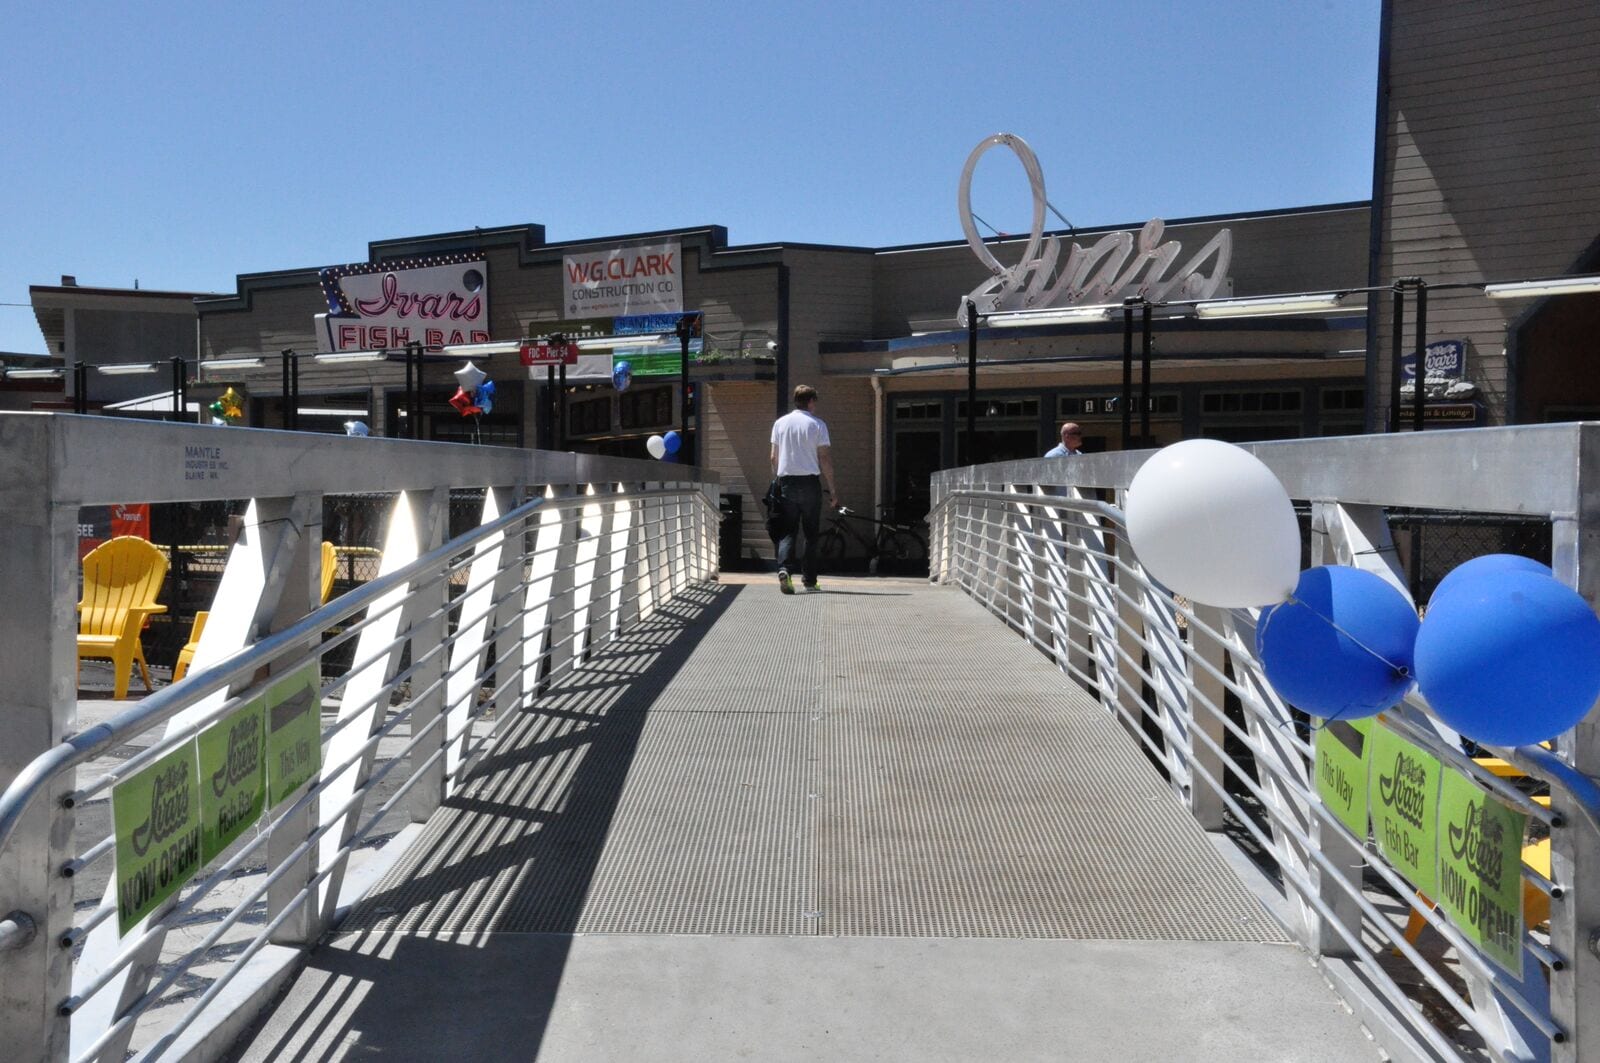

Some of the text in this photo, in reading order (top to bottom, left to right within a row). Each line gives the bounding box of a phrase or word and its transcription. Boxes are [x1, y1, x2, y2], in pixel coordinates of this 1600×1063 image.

[572, 282, 655, 301] CONSTRUCTION
[339, 324, 410, 351] FISH
[528, 347, 540, 359] FDC
[546, 347, 558, 358] Pier
[185, 446, 220, 459] MANTLE
[1322, 751, 1353, 811] This Way
[219, 798, 236, 839] Fish
[1385, 816, 1419, 870] Fish Bar
[122, 825, 199, 921] NOW OPEN!
[1441, 857, 1515, 955] NOW OPEN!
